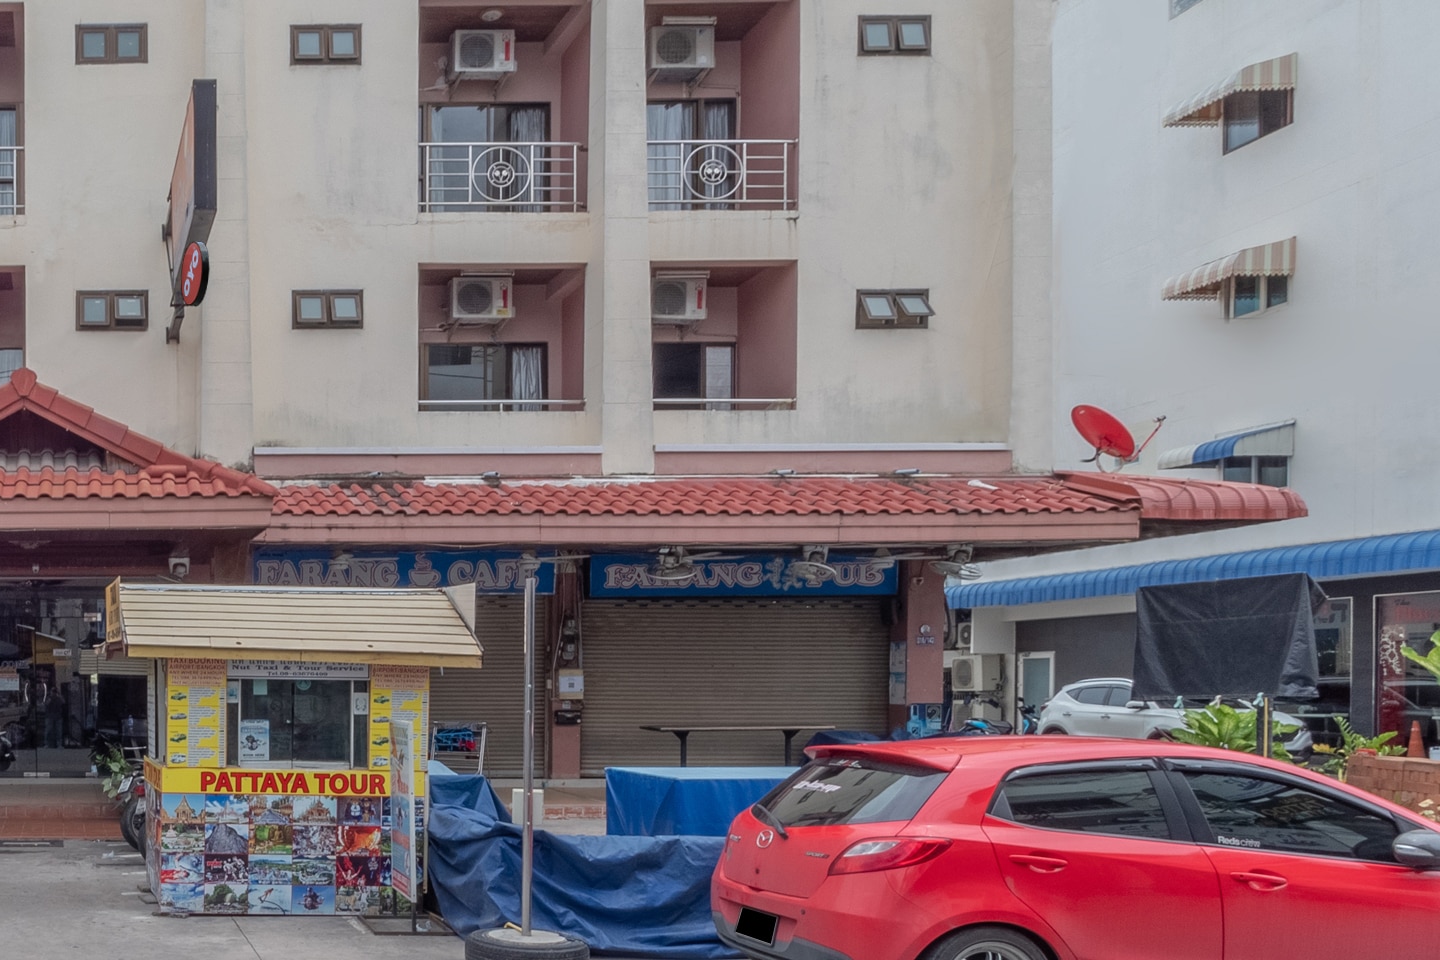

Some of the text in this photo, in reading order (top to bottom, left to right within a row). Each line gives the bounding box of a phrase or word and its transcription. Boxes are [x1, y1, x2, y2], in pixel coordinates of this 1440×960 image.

[604, 562, 763, 588] FAANG
[298, 664, 321, 672] Tour
[200, 771, 386, 795] PATTAYA TOUR
